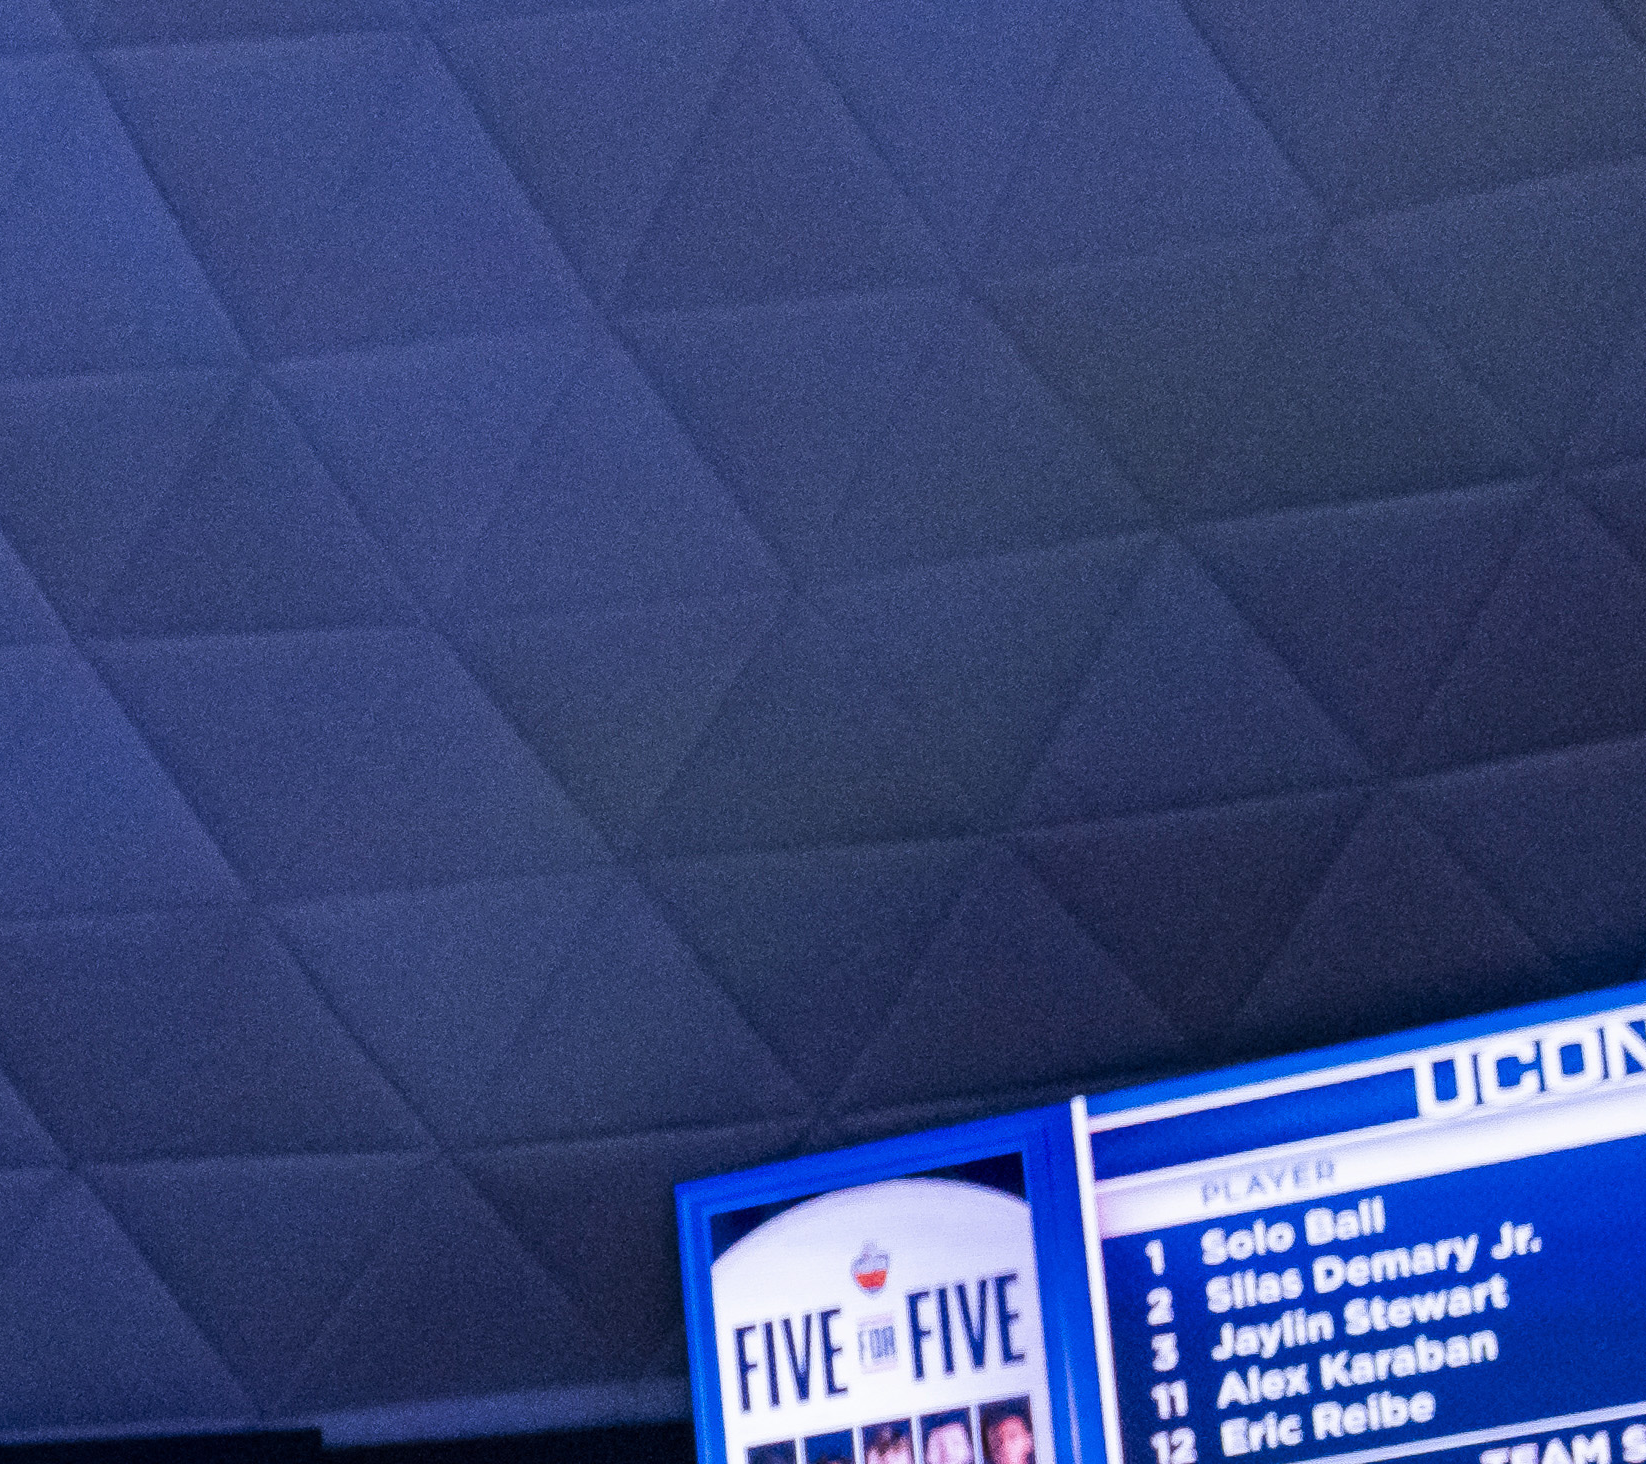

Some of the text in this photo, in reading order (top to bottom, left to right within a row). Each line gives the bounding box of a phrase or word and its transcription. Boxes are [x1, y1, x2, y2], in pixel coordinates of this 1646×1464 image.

[1200, 1157, 1337, 1206] PLAYER
[1145, 1196, 1386, 1276] 1 Solo Ball
[1146, 1288, 1174, 1326] 2
[1313, 1233, 1480, 1294] Demary
[1490, 1221, 1542, 1260] Jr.
[733, 1307, 849, 1413] FIVE
[905, 1273, 1026, 1382] FIVE
[1211, 1308, 1335, 1362] Jaylin
[1344, 1273, 1509, 1336] Stewart
[1151, 1329, 1498, 1420] 11 Alex Karaban
[1220, 1411, 1303, 1458] Eric
[1312, 1390, 1436, 1440] Reibe
